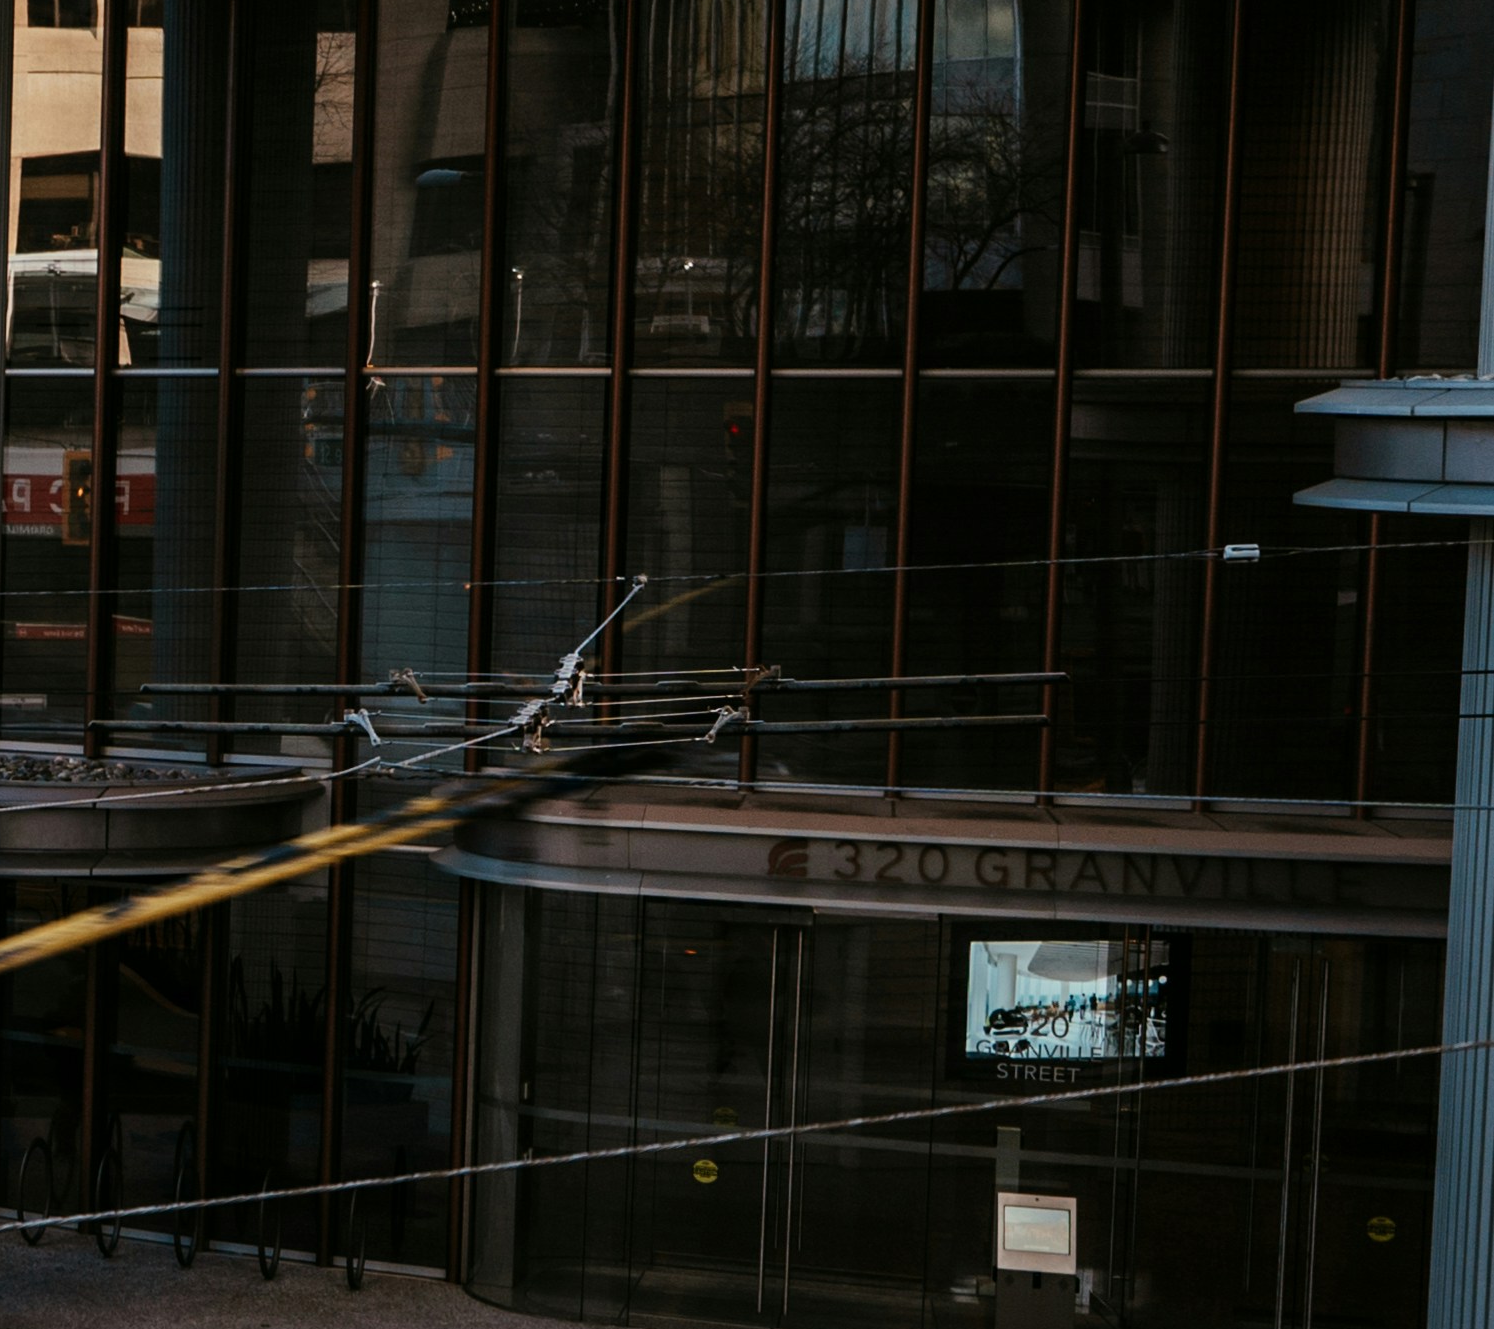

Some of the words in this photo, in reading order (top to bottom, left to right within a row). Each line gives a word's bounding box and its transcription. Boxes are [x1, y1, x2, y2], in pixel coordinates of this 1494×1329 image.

[834, 839, 950, 883] 320
[974, 847, 1372, 903] GRANVILLE
[976, 1039, 1103, 1064] GRANVILLE
[997, 1063, 1082, 1083] STREET
